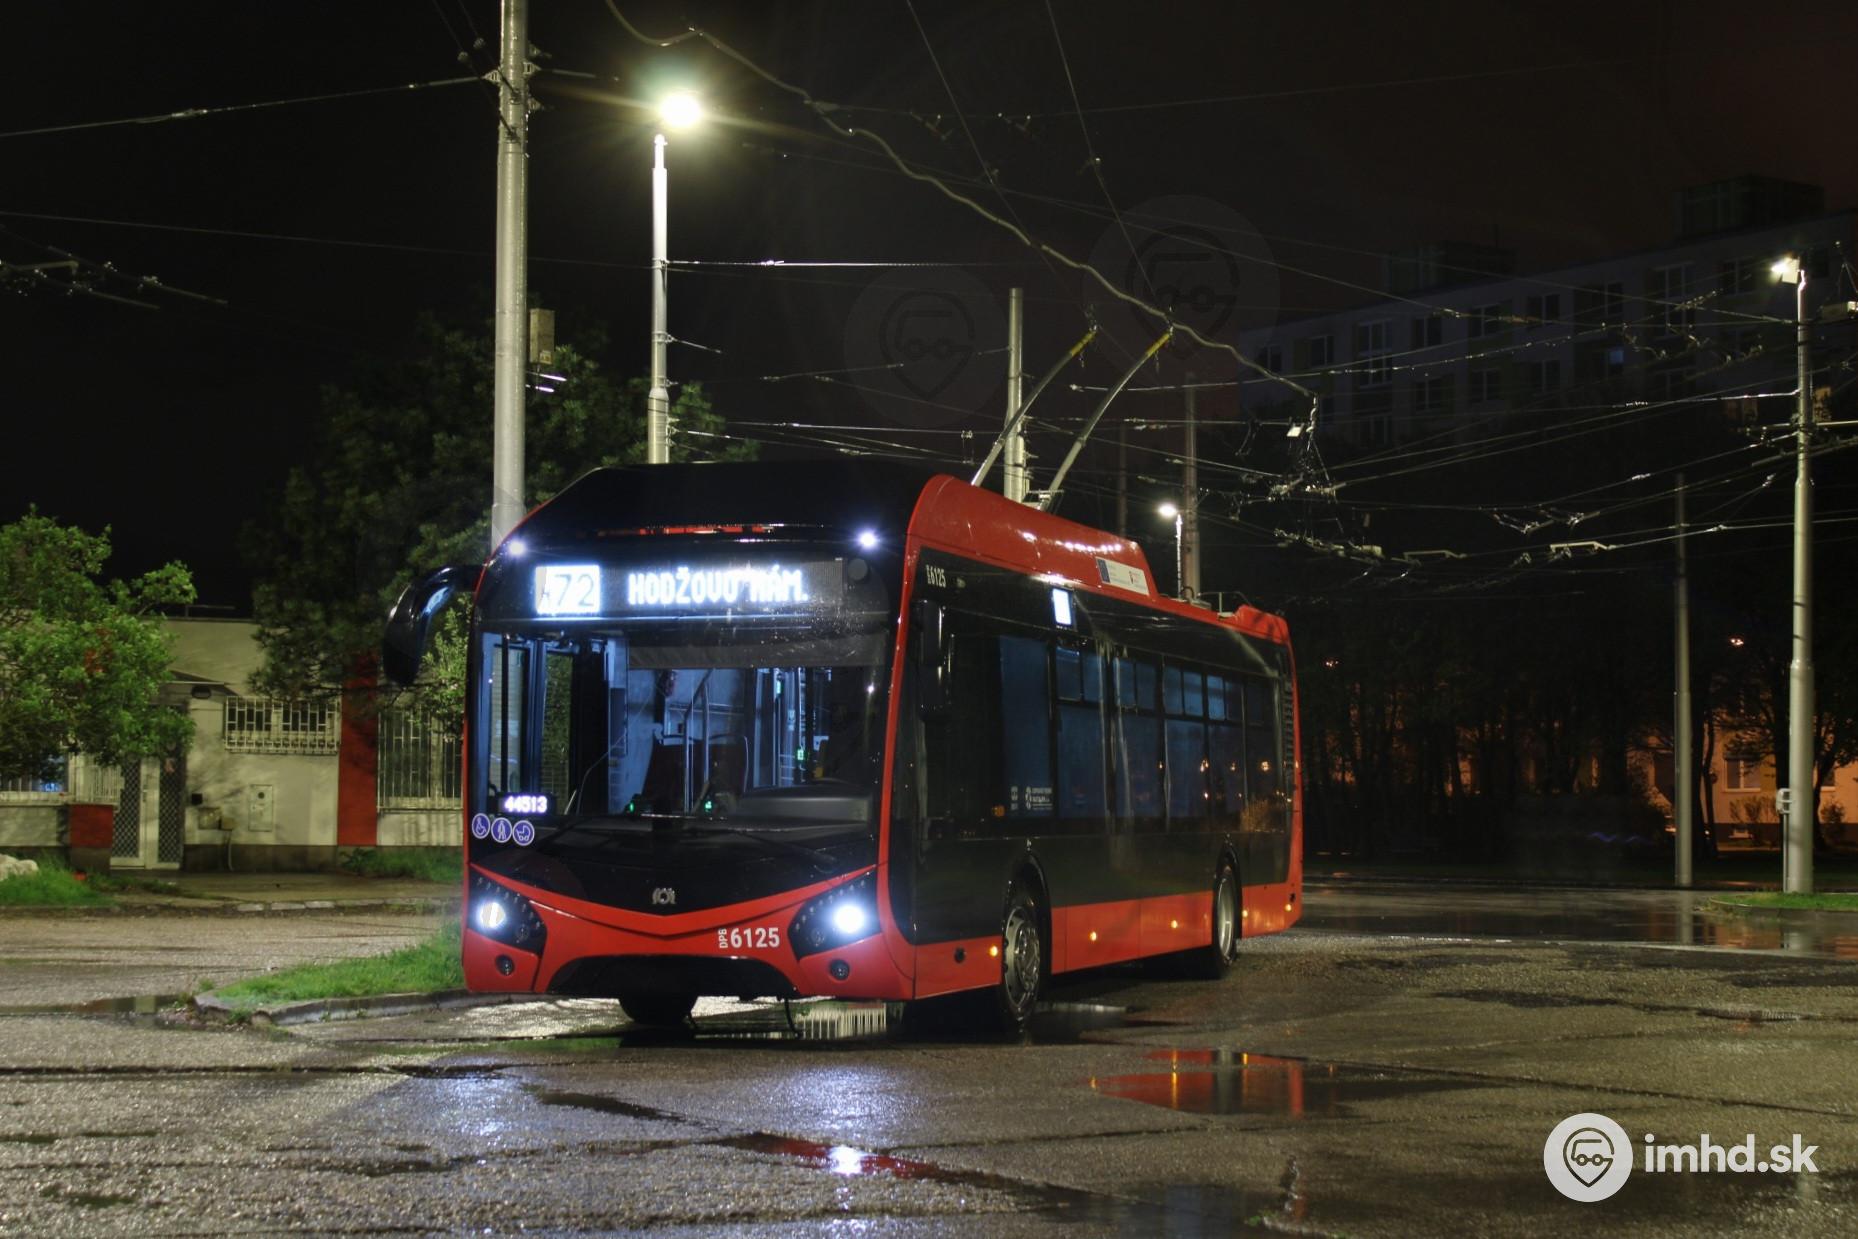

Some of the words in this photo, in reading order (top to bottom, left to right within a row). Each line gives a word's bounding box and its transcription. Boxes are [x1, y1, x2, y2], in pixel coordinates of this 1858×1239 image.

[628, 566, 738, 604] HODŽOVO
[930, 566, 947, 588] 6125
[553, 572, 595, 608] 72
[504, 796, 548, 813] 44513
[718, 928, 728, 949] DPB
[730, 927, 780, 949] 6125
